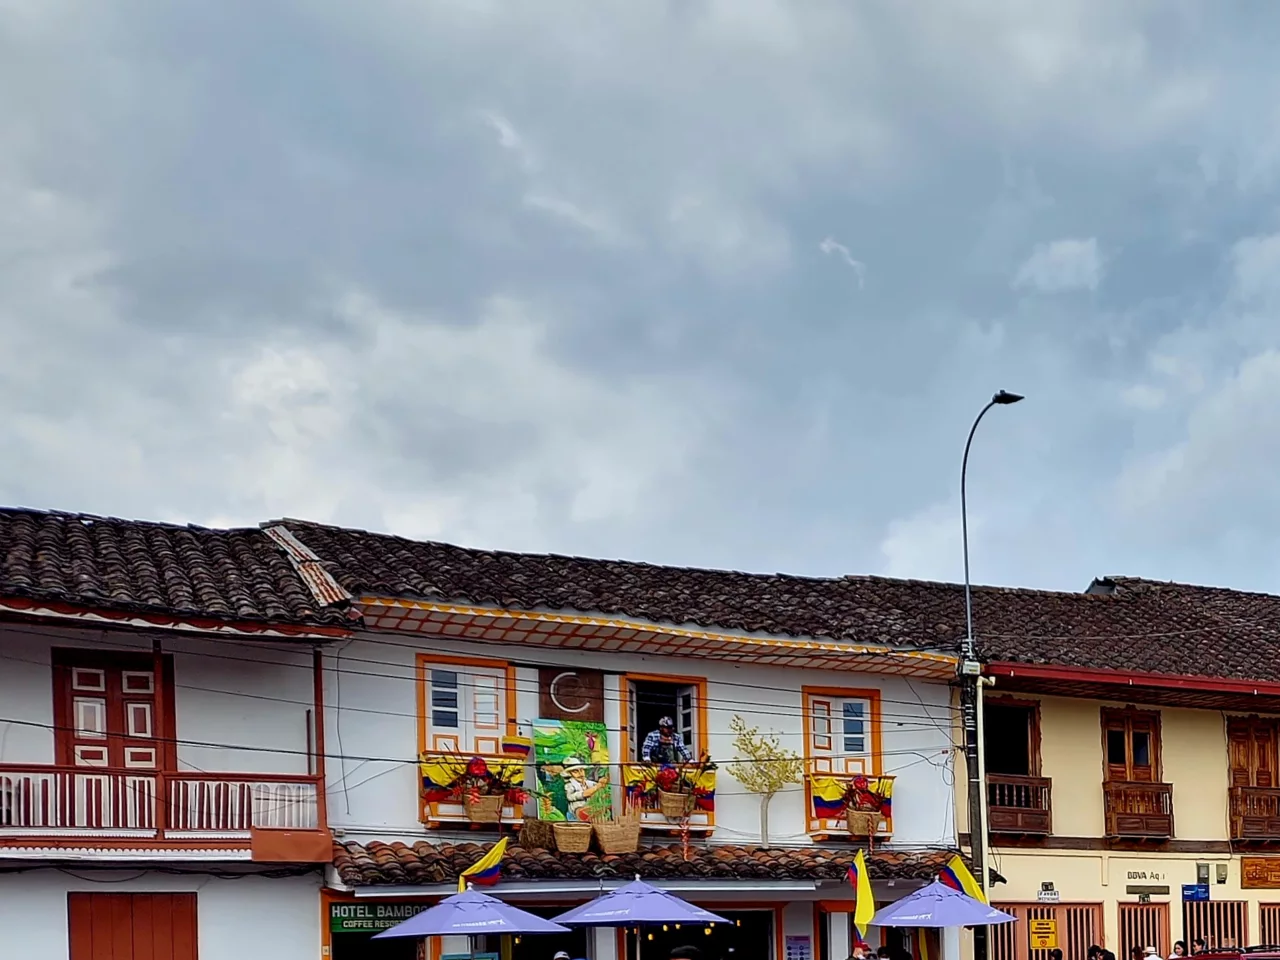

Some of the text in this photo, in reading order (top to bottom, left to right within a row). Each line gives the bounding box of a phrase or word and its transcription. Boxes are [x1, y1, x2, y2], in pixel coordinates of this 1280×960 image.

[1127, 871, 1147, 880] BBVA
[331, 905, 373, 918] HOTEL
[343, 920, 373, 928] COFFEE
